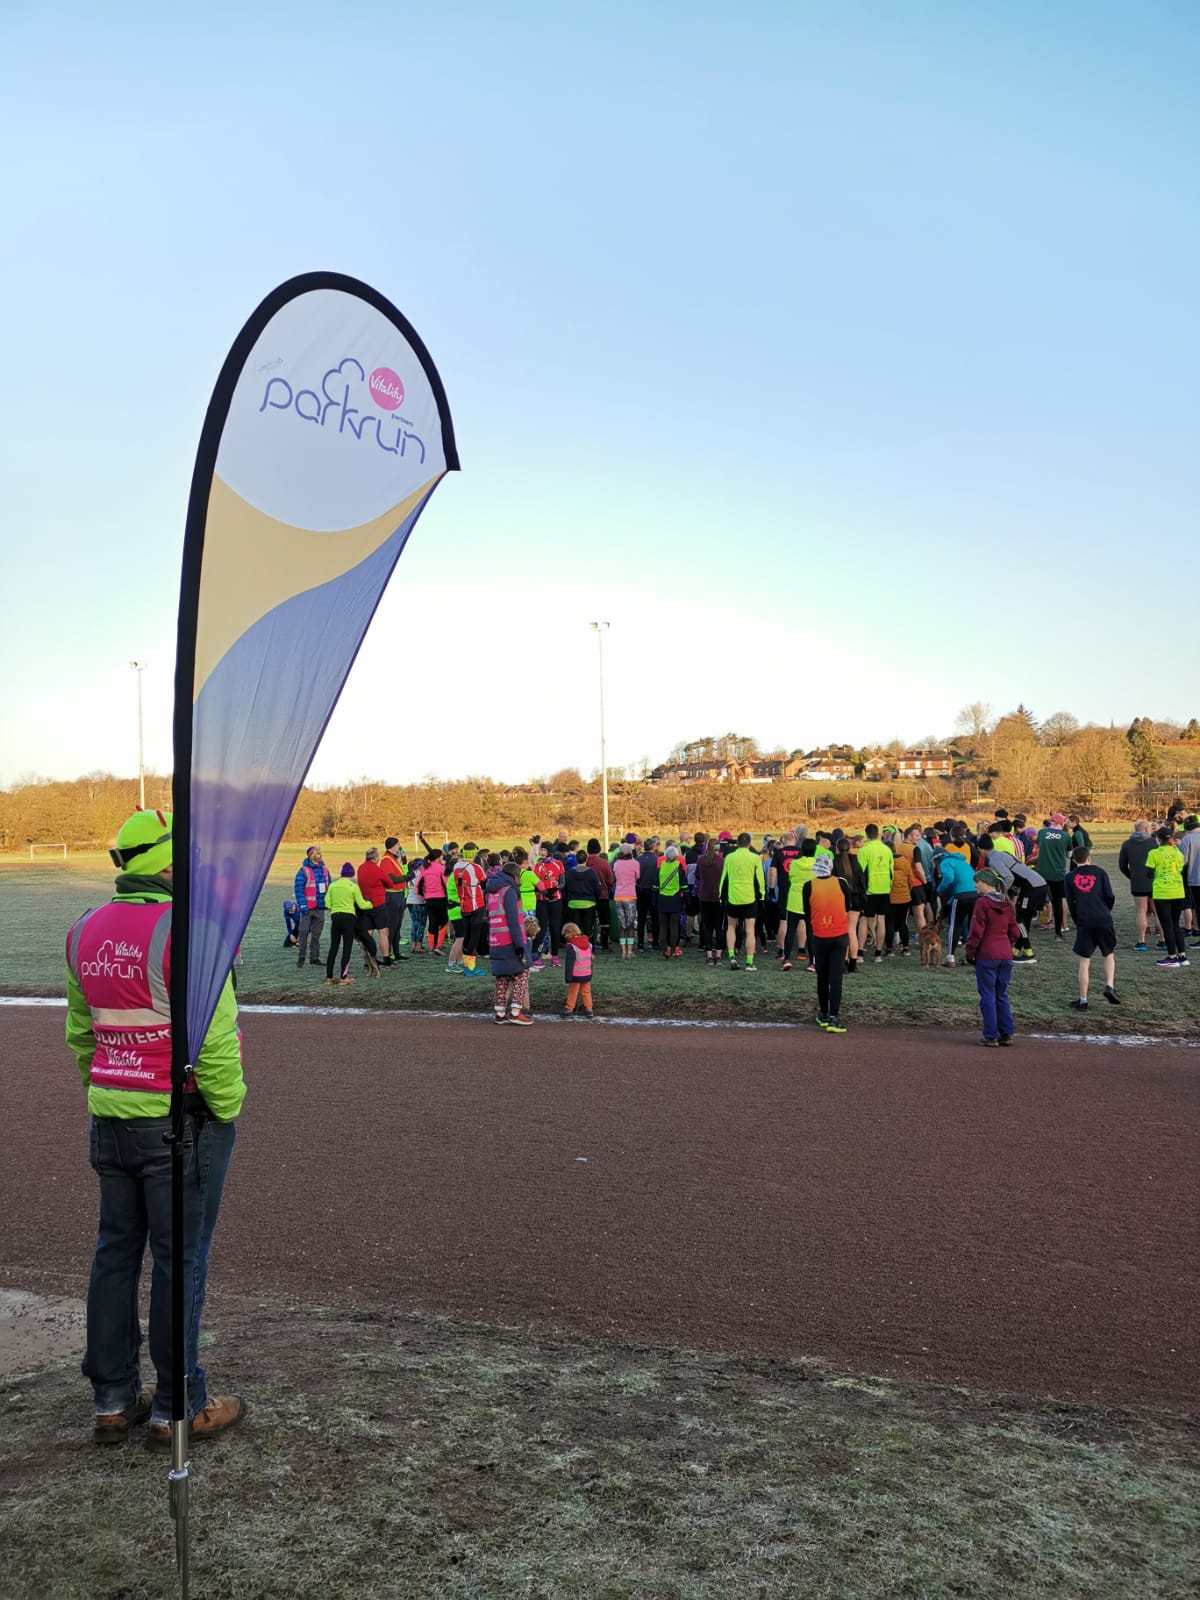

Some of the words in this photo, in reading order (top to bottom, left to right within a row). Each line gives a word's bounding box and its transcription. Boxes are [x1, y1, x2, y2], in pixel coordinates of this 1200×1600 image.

[370, 374, 403, 403] Vitality
[259, 358, 425, 464] parkrun
[1045, 831, 1062, 840] 250
[81, 940, 143, 981] parkrun
[115, 941, 143, 963] Vitality
[106, 1046, 143, 1071] Vitality
[123, 1070, 156, 1080] INSURANCE
